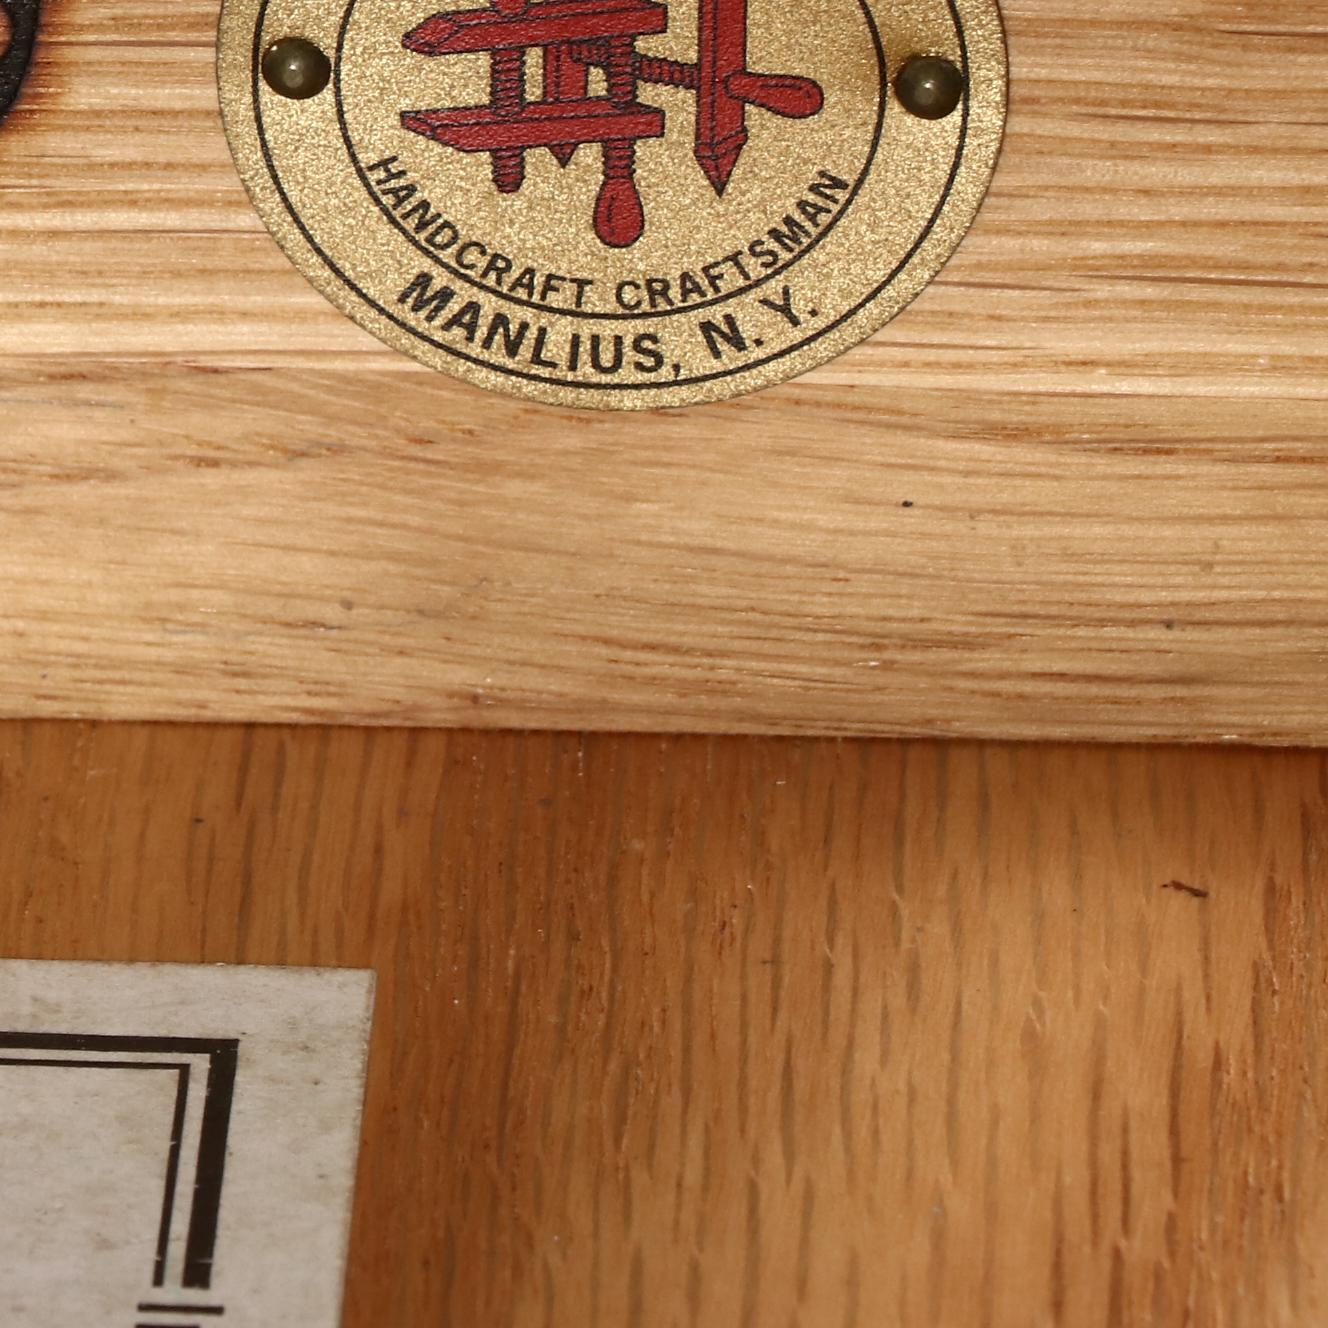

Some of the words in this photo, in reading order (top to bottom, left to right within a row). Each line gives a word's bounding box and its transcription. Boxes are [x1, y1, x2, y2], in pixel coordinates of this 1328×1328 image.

[366, 156, 596, 310] HANDCRAFT
[614, 169, 851, 312] CRAFTSMAN
[397, 272, 682, 380] MANLIUS,
[699, 312, 765, 361] N.
[759, 284, 820, 329] Y.
